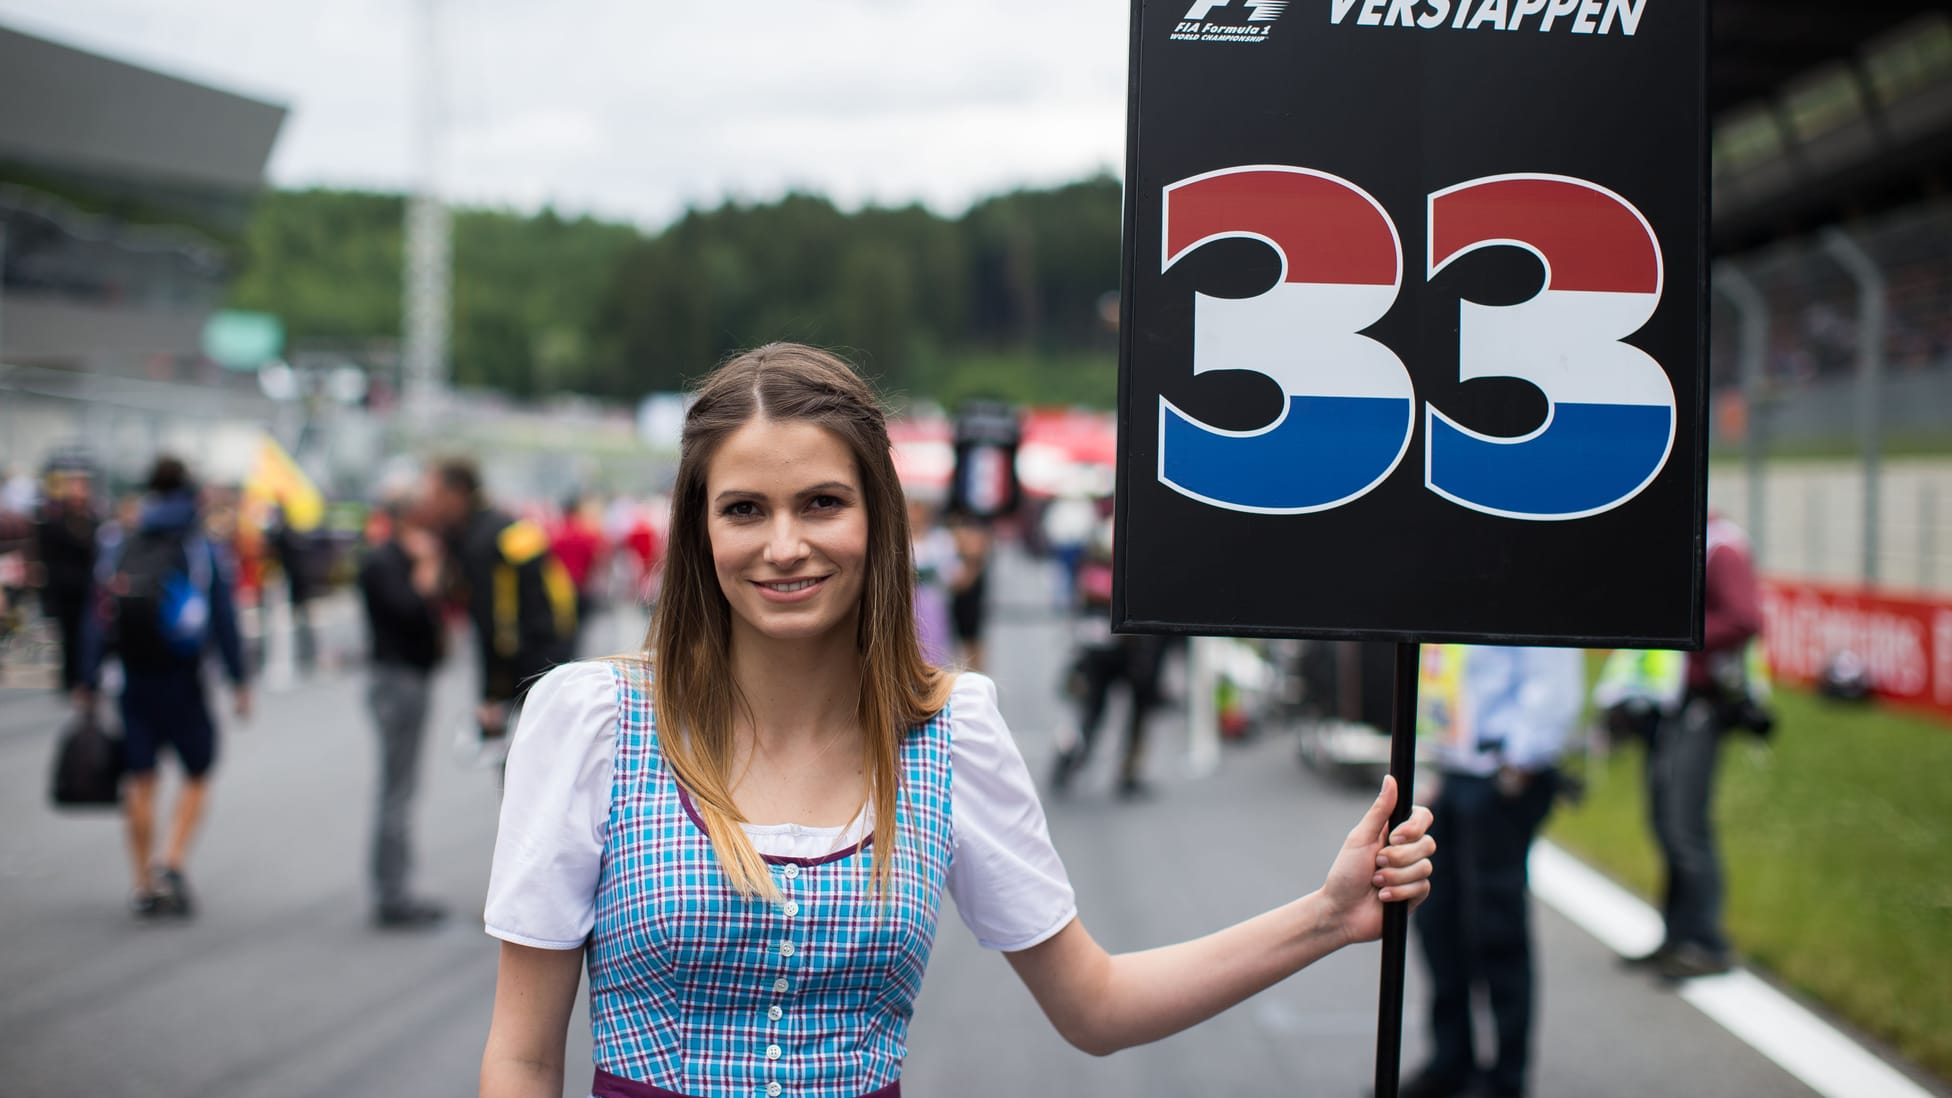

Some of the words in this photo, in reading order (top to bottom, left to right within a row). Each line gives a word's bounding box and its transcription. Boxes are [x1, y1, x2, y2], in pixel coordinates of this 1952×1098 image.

[1174, 22, 1200, 32] FIA
[1201, 23, 1260, 34] Formula
[1261, 25, 1271, 35] 1
[1201, 34, 1265, 43] CHAMPIONSHIP
[1158, 164, 1676, 521] 33
